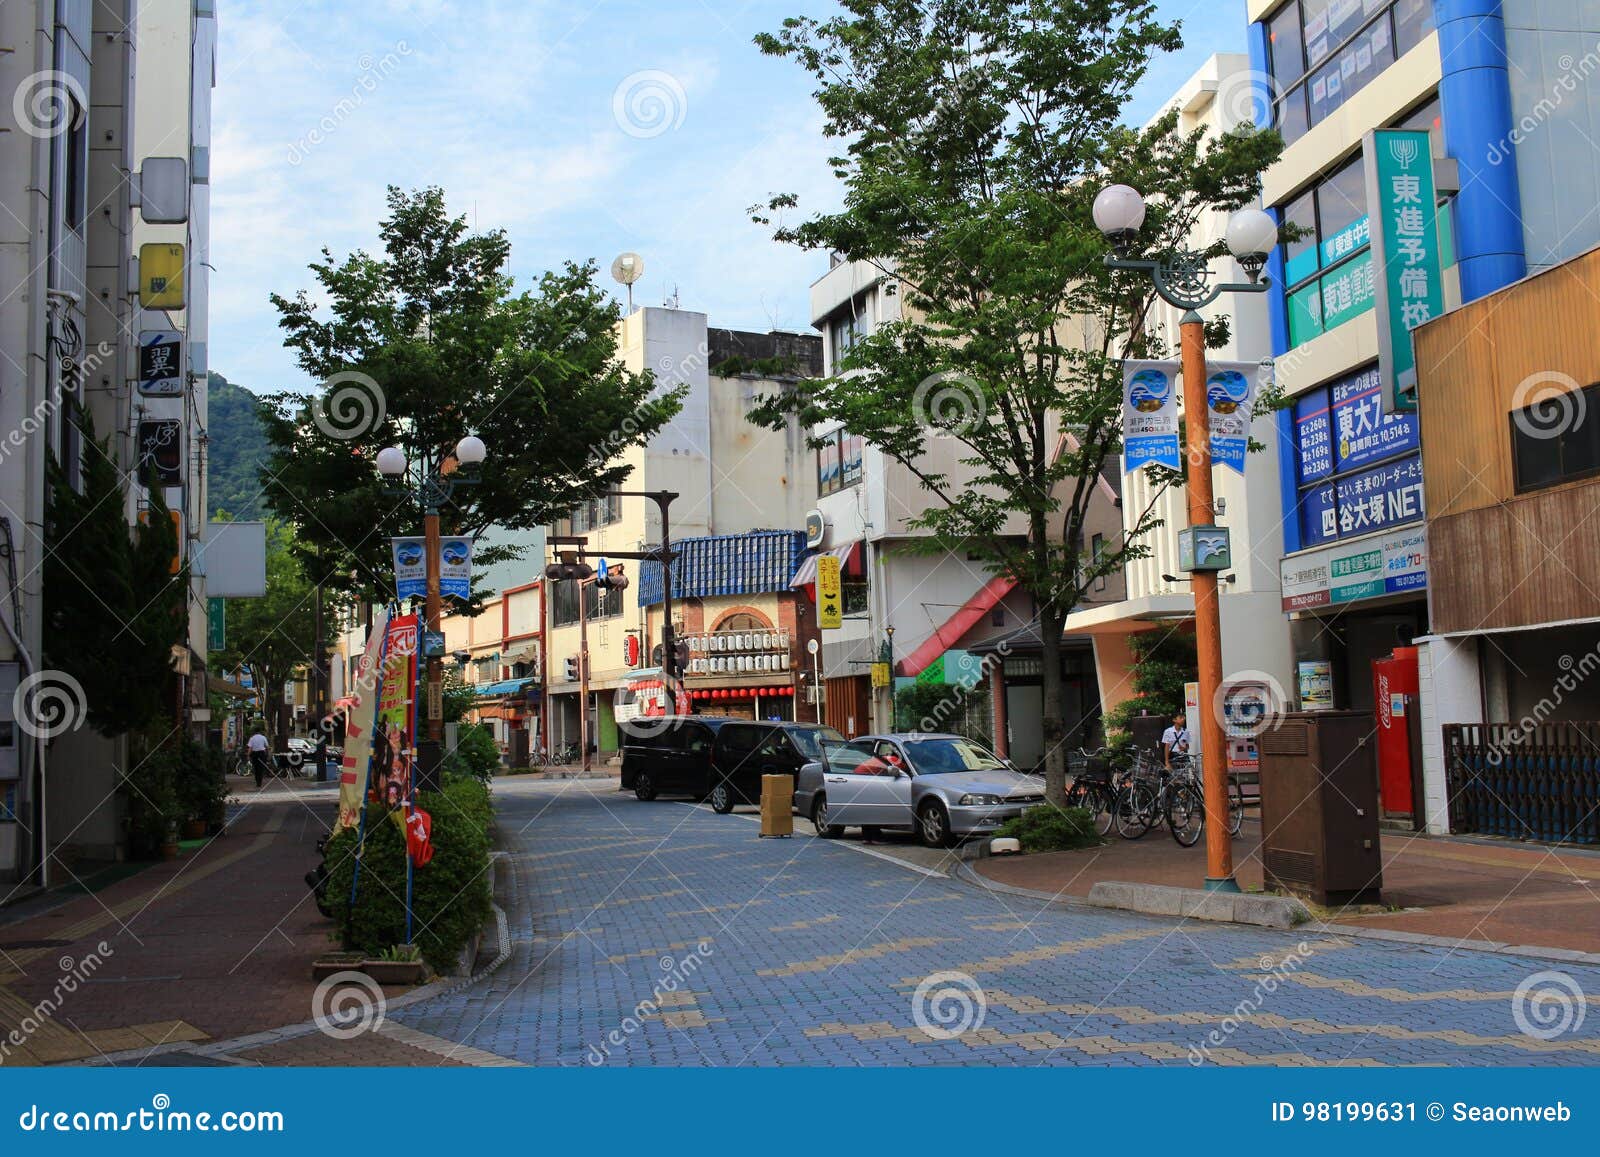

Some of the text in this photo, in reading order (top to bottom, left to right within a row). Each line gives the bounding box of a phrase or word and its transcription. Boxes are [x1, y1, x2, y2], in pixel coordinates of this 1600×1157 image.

[1391, 174, 1430, 331] 東進予備校
[146, 346, 176, 377] 翼
[1337, 393, 1404, 441] 東大7
[1321, 482, 1425, 537] 四谷大塚 NET
